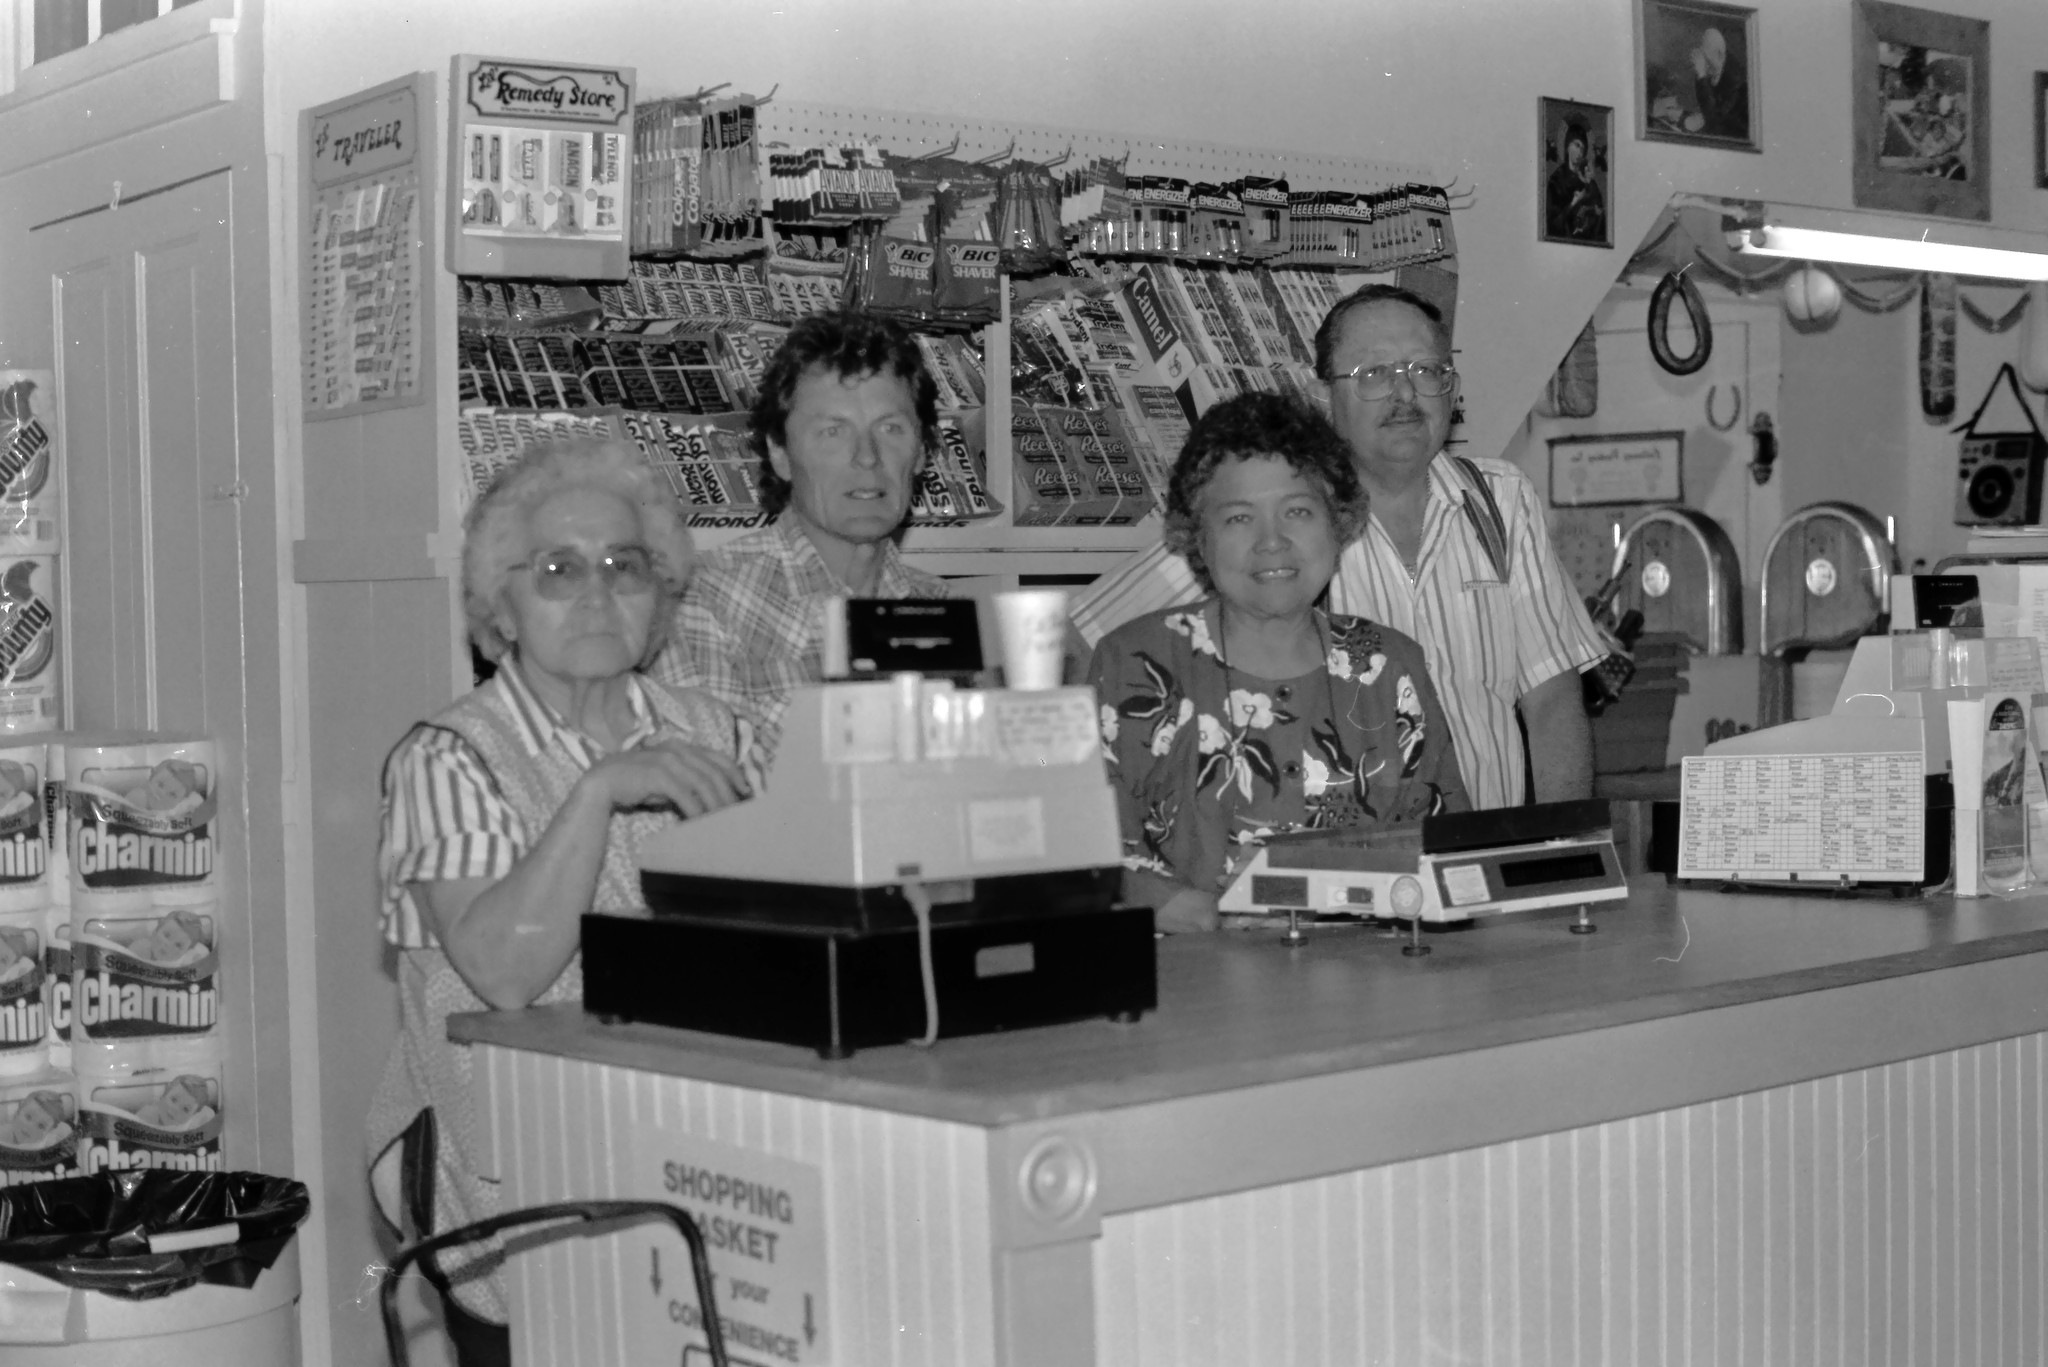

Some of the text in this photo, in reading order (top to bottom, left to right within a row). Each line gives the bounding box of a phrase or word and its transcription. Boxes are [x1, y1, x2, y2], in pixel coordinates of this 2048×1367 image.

[495, 80, 563, 108] Remedy
[570, 87, 615, 107] Store
[334, 120, 402, 166] TRAVELER
[566, 139, 580, 188] ANACIN
[607, 135, 618, 185] TYLENOL
[688, 155, 700, 224] Colgate
[1144, 188, 1188, 202] ENERGIZER
[1245, 188, 1288, 203] ENERGIZER
[1408, 194, 1448, 208] ENERGIZER
[1198, 195, 1243, 211] ENERGIZER
[1325, 203, 1372, 218] ENERGIZER
[889, 266, 929, 280] SHAVER
[953, 266, 995, 279] SHAVER
[1132, 277, 1173, 350] Camel
[1020, 435, 1064, 452] Reese's
[1081, 435, 1125, 453] Reese's
[942, 428, 986, 508] Mounds
[1034, 467, 1078, 485] Reese's
[1095, 466, 1142, 483] Reese's
[687, 513, 758, 528] lmond
[101, 804, 193, 831] Squeezably Soft
[78, 819, 212, 875] Charmin
[105, 955, 197, 979] Squeezably Soft
[80, 972, 216, 1027] Charmin
[114, 1122, 205, 1145] Squeezably Soft
[664, 1160, 793, 1224] SHOPPING
[699, 1212, 779, 1263] ASKET
